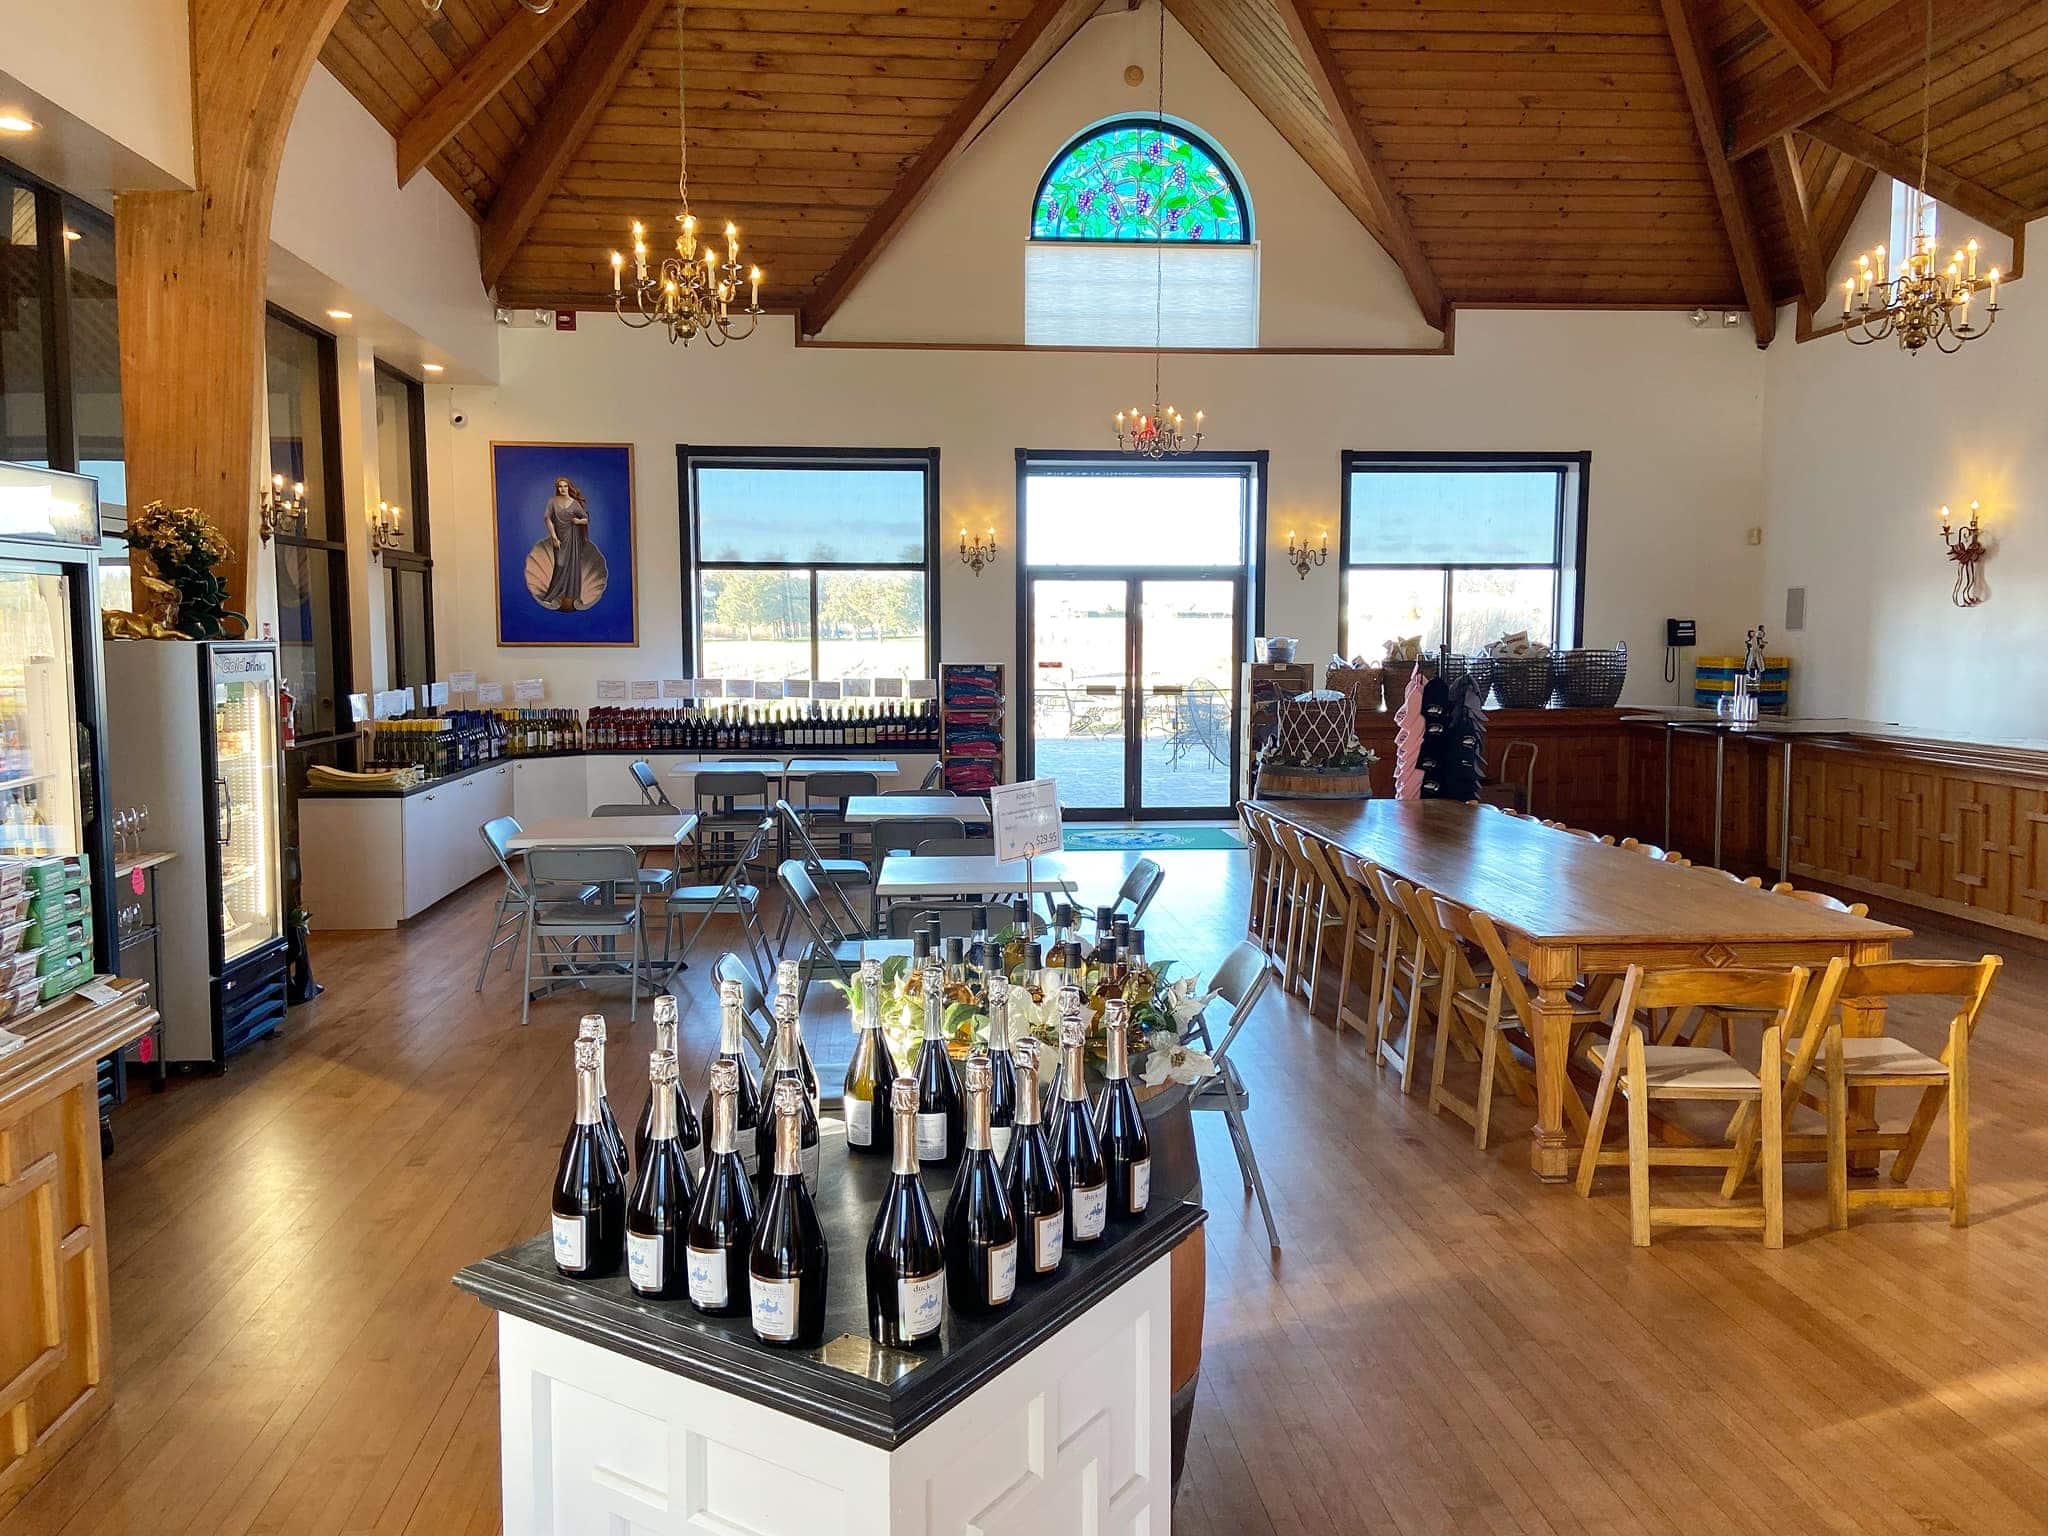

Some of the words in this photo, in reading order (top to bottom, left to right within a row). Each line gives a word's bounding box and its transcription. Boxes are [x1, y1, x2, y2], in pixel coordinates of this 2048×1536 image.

[223, 657, 245, 674] Cold
[246, 661, 265, 672] Drinks
[1036, 832, 1057, 846] $29.95
